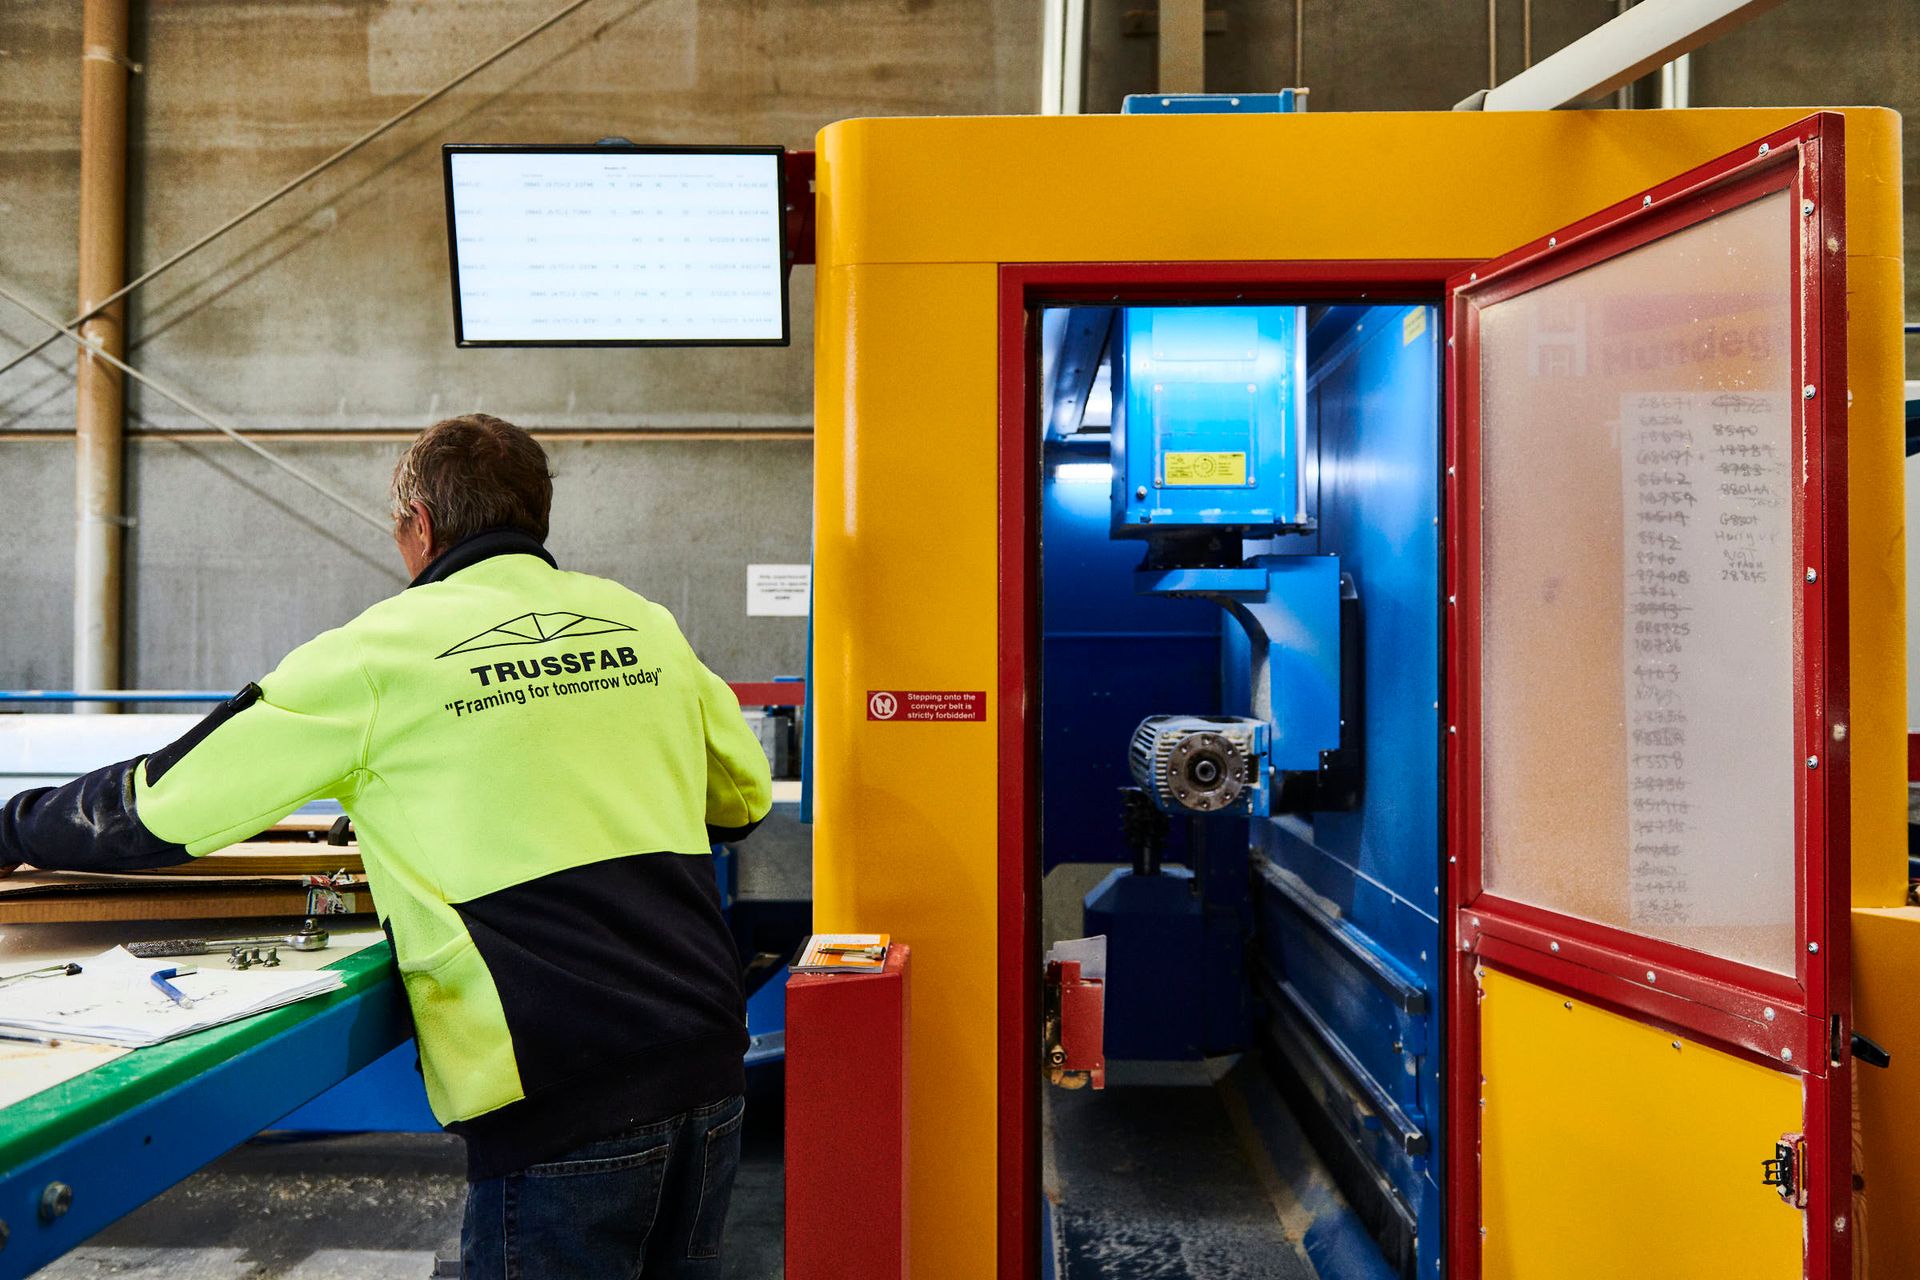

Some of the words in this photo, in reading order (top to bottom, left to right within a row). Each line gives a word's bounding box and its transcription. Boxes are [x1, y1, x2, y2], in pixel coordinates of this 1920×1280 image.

[471, 646, 639, 687] TRUSSFAB
[445, 690, 527, 717] "Framing
[528, 684, 550, 699] for
[553, 675, 621, 696] tomorrow
[623, 667, 663, 687] today"
[907, 693, 942, 702] Stepping
[944, 693, 962, 701] onto
[963, 693, 976, 701] the
[911, 703, 947, 711] conveyor
[948, 702, 964, 710] belt
[965, 702, 973, 710] is
[907, 712, 934, 720] strictly
[936, 711, 976, 719] forbidden!
